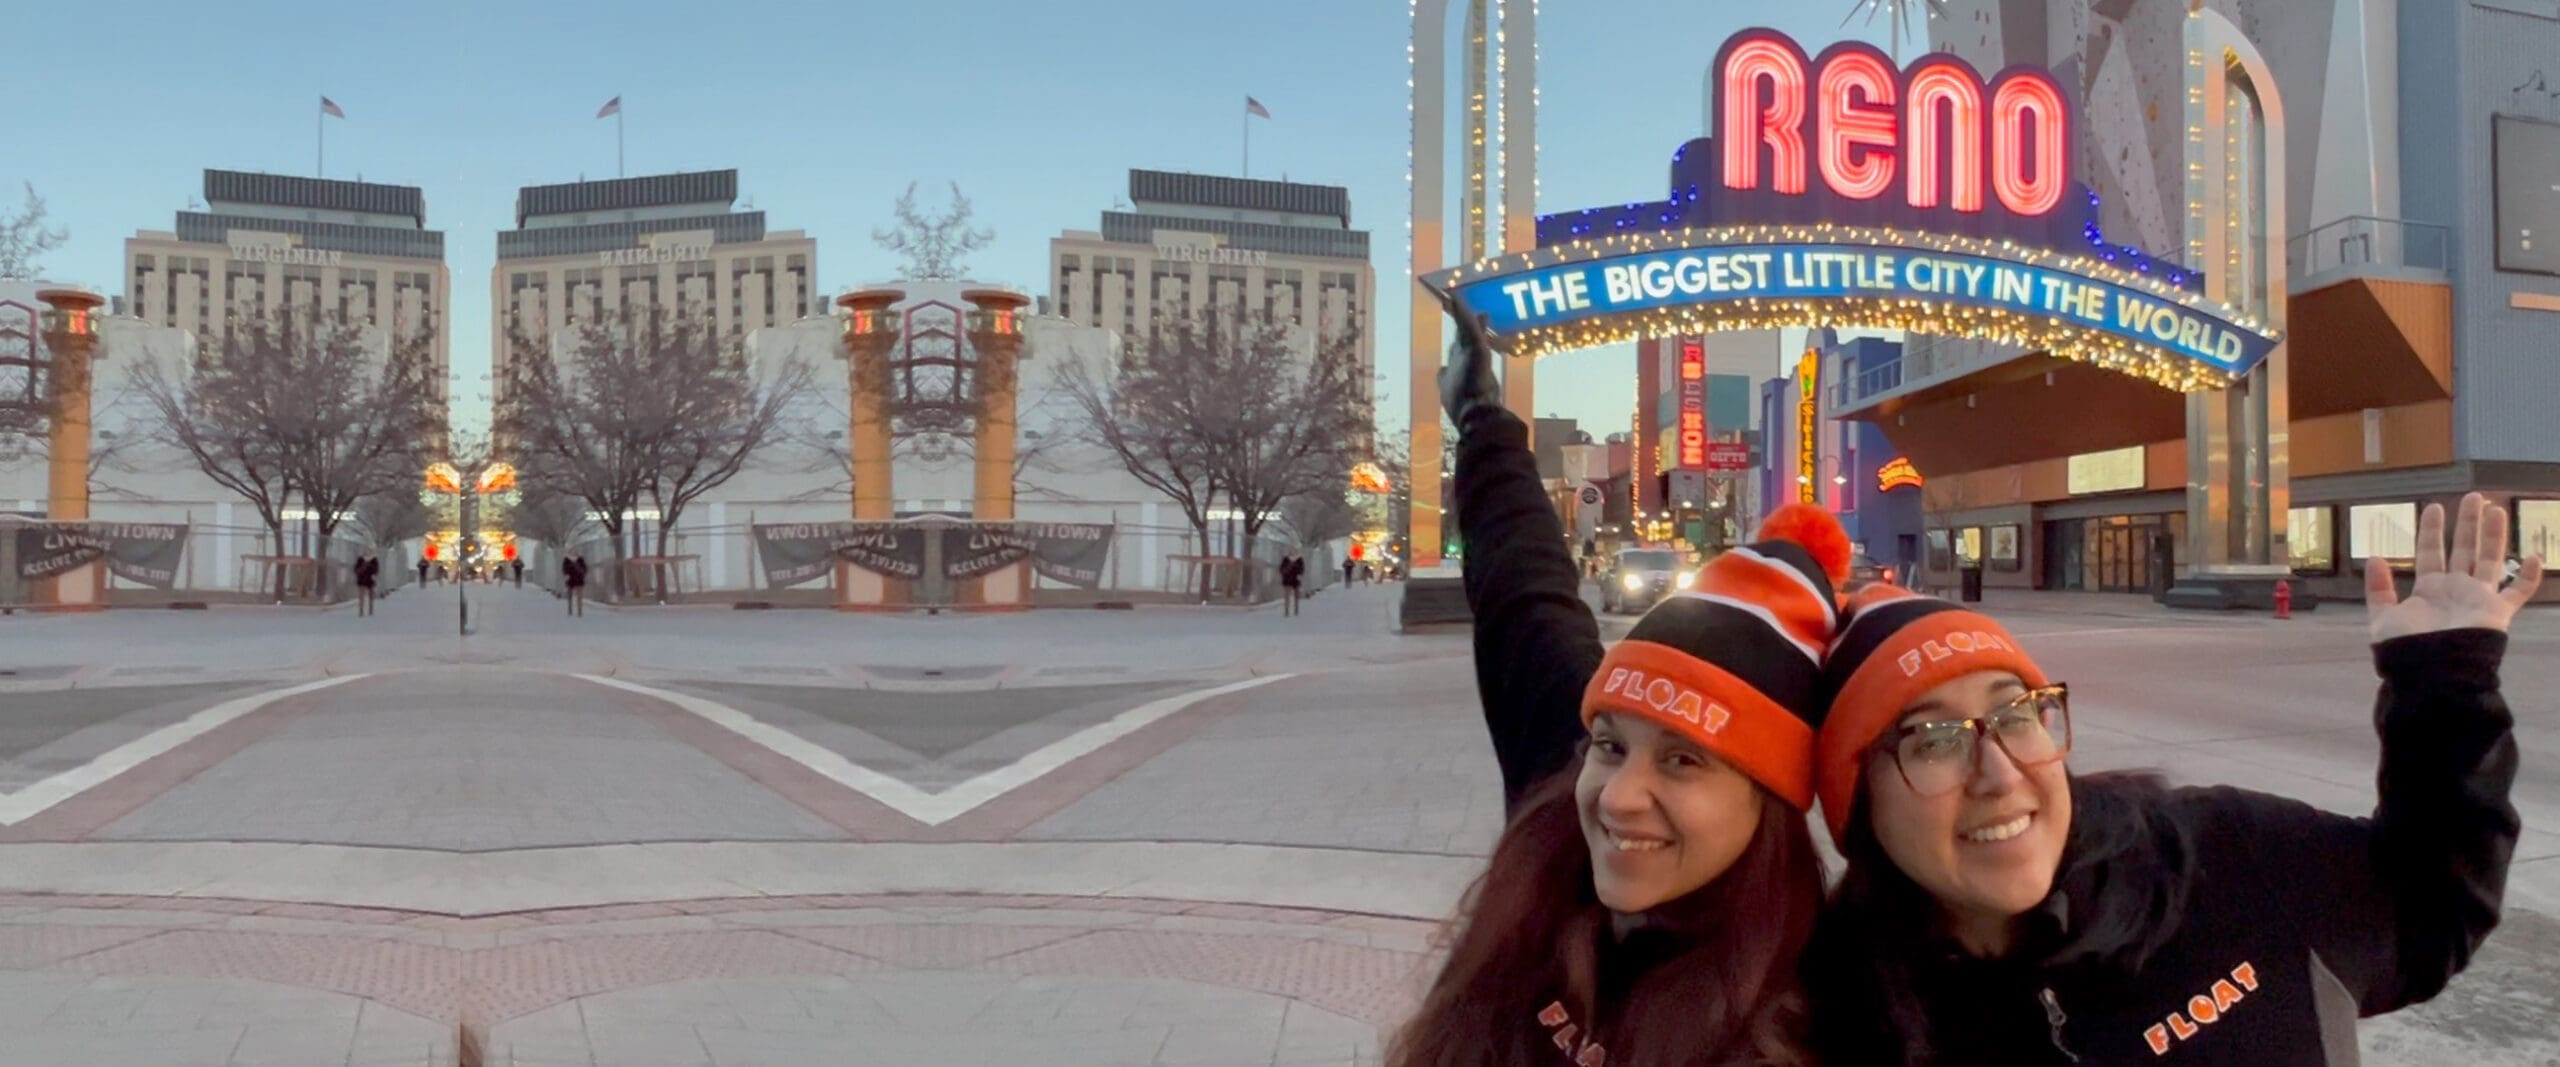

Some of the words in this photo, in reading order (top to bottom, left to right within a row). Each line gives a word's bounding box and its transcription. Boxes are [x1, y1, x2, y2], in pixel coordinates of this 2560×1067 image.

[1723, 38, 2065, 216] RENO
[230, 244, 343, 266] VIRGINIAN
[1156, 244, 1268, 266] VIRGINIAN
[1503, 270, 1590, 320] THE
[1604, 253, 1771, 303] BIGGEST
[1783, 252, 1896, 290] LITTLE
[1905, 256, 1985, 296] CITY
[1992, 268, 2034, 304] IN
[2040, 277, 2105, 321] THE
[2118, 294, 2243, 363] WORLD
[1604, 668, 1730, 735] FLOAT
[2143, 961, 2259, 1056] FLOAT
